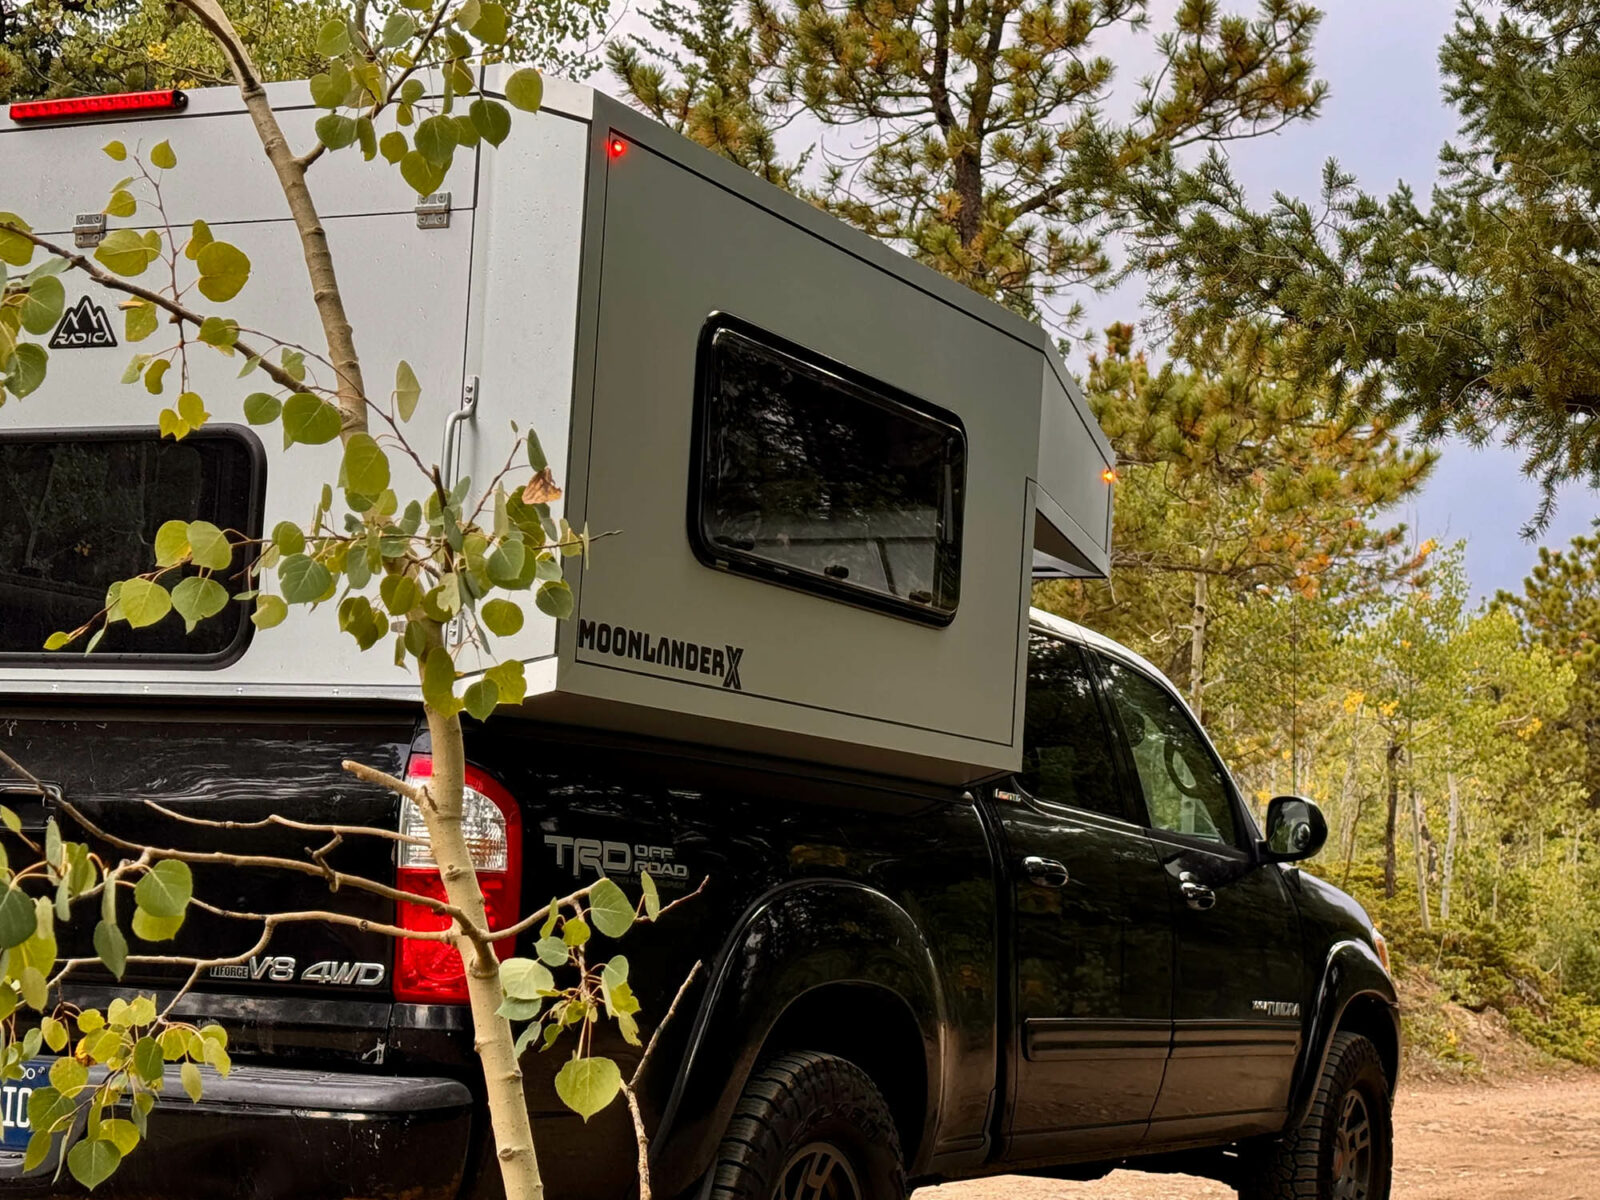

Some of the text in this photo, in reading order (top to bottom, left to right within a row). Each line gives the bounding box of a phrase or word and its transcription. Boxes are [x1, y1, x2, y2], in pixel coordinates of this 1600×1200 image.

[544, 834, 676, 880] TRD OFF
[634, 860, 689, 879] ROAD
[250, 956, 296, 981] V8
[301, 961, 385, 985] 4WD
